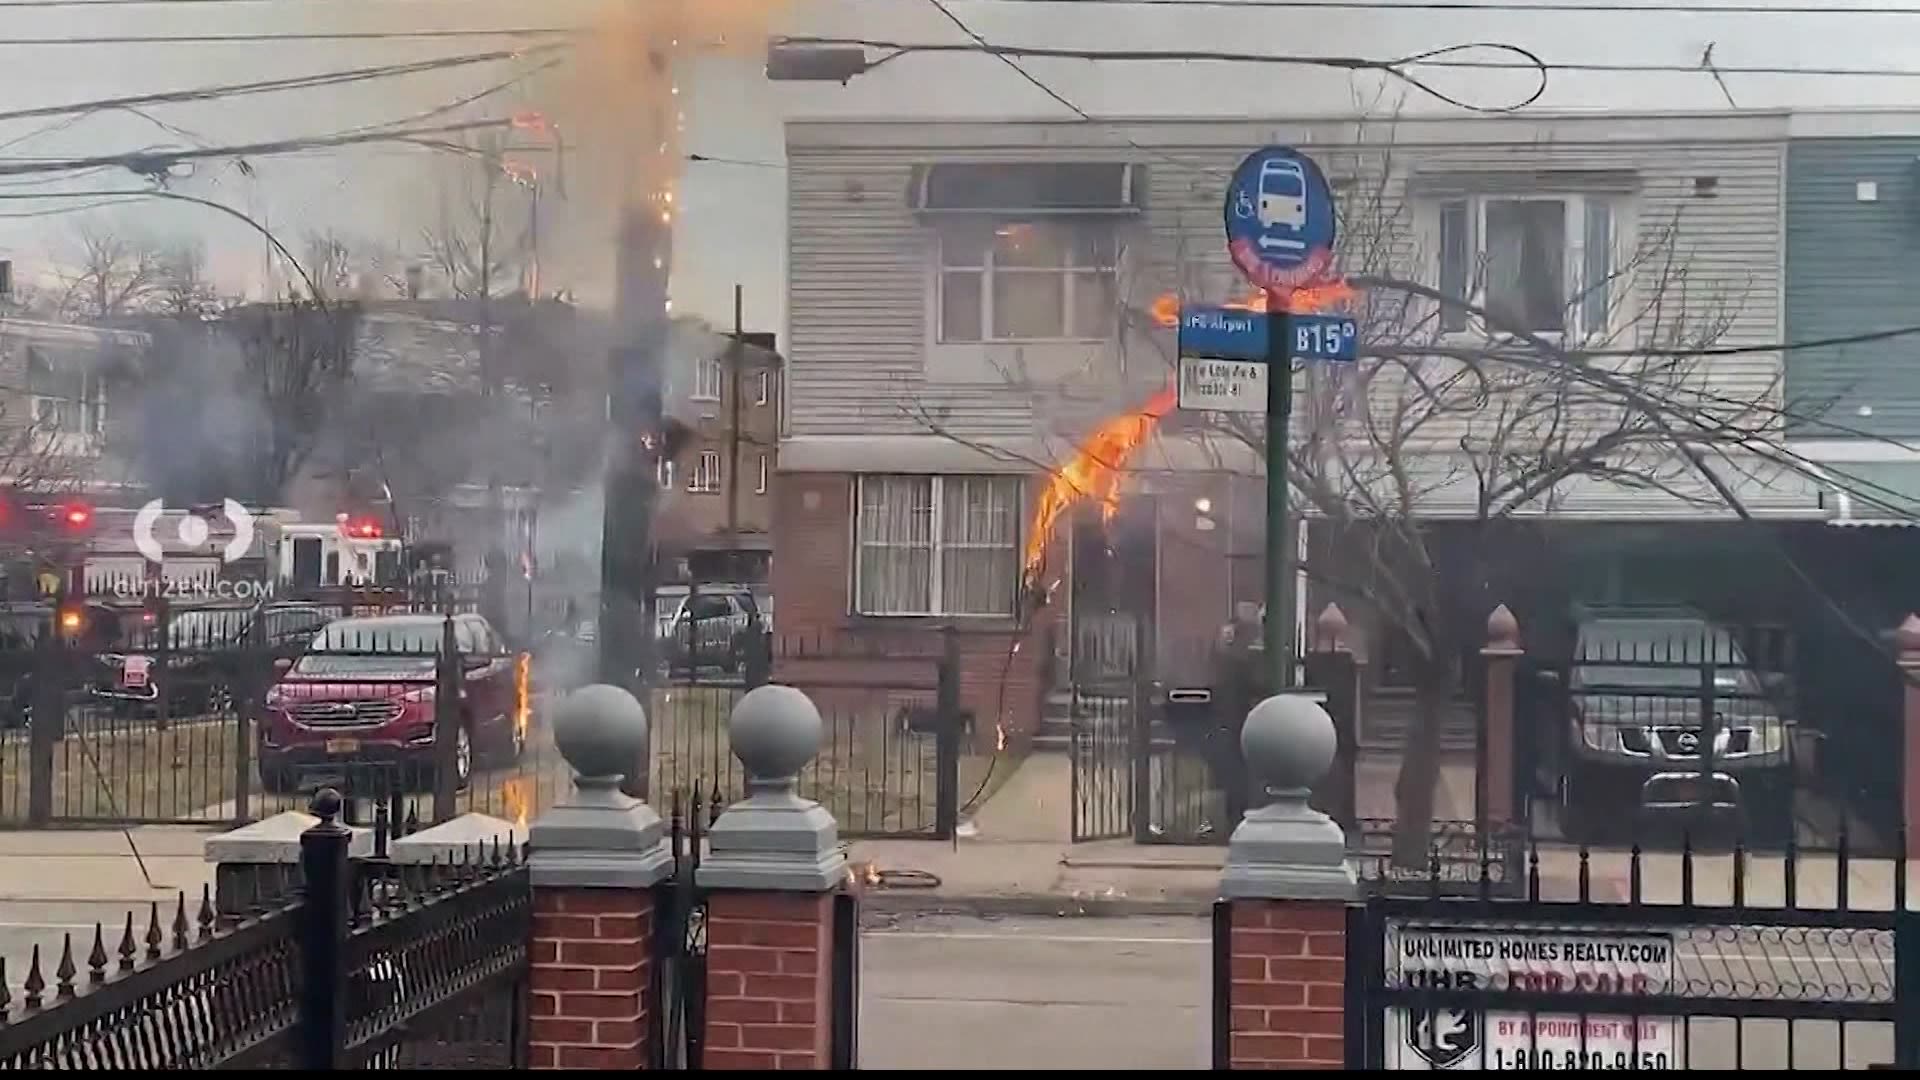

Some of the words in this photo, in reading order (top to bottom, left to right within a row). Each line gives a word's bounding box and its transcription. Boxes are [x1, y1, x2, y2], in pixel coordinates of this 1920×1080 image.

[1405, 938, 1494, 959] UNLIMITED
[1500, 940, 1558, 961] HOMES
[1564, 943, 1667, 964] REALTY.COM
[1498, 1021, 1515, 1036] BY
